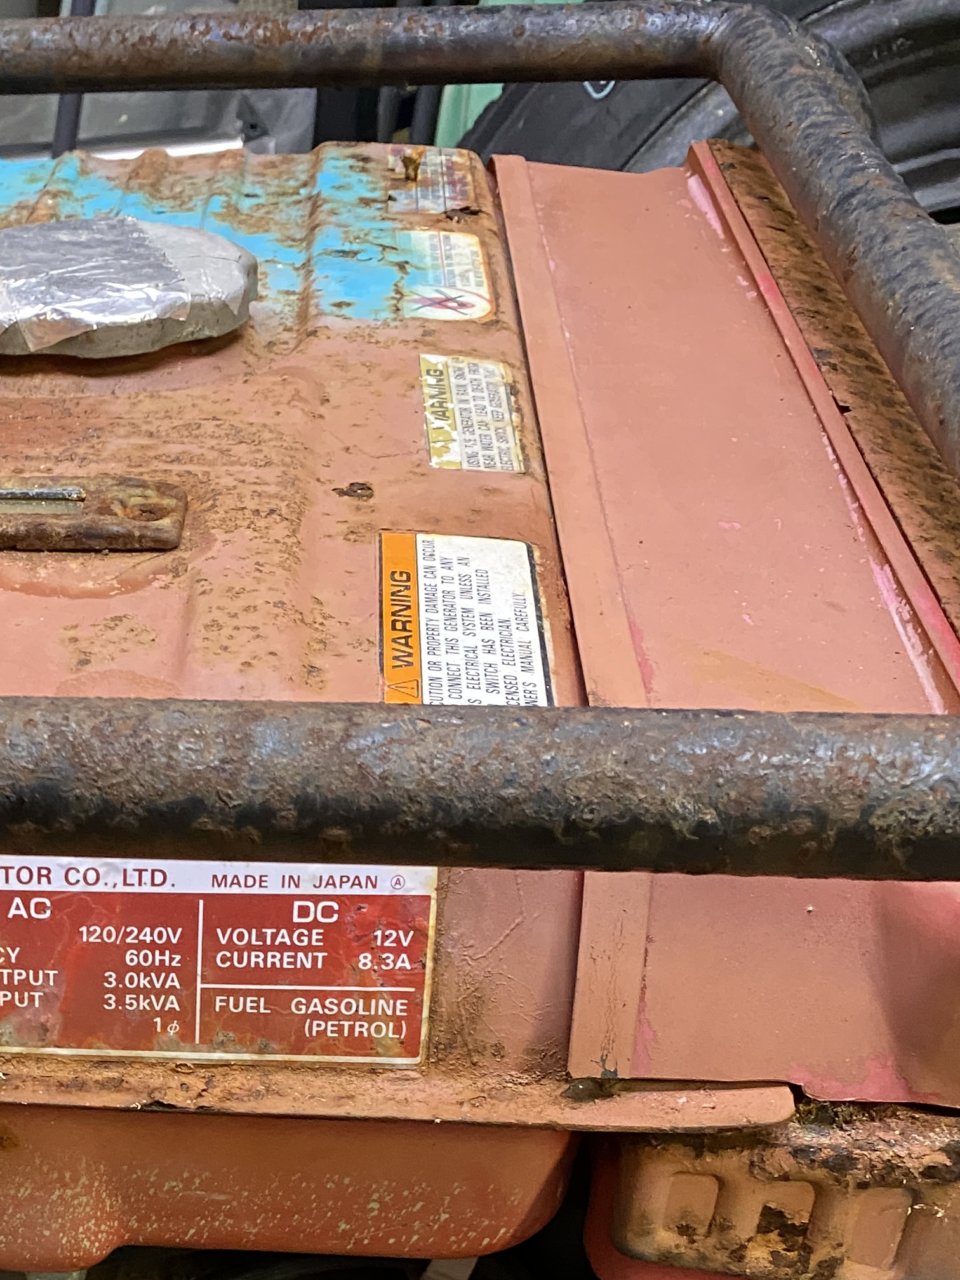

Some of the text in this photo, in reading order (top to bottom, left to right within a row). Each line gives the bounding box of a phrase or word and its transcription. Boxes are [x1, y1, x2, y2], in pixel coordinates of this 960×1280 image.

[457, 556, 470, 566] AN
[424, 567, 436, 580] CAN
[458, 574, 473, 599] UNLESS
[425, 583, 439, 613] DAMAGE
[391, 571, 412, 668] WARNING
[440, 556, 462, 699] CONNECT THIS GENERATOR TO ANY
[461, 608, 476, 636] SYSTEM
[426, 617, 440, 656] PROPERTY
[476, 569, 500, 694] SWITCH HAS BEEN INSTALLED
[428, 661, 442, 671] OR
[518, 640, 535, 673] MANUAL
[465, 646, 480, 690] ELECTRICAL
[211, 874, 378, 889] MADE IN JAPAN
[7, 898, 52, 920] AC
[292, 901, 338, 923] DC
[79, 927, 182, 946] 120/240V
[216, 928, 413, 949] VOLTAGE 12V
[125, 949, 181, 967] 60Hz
[216, 951, 413, 970] CURRENT 8.3A
[103, 971, 180, 989] 3.0kVA
[103, 993, 179, 1011] 3.5kVA
[216, 996, 407, 1016] FUEL GASOLINE
[304, 1020, 407, 1040] (PETROL)
